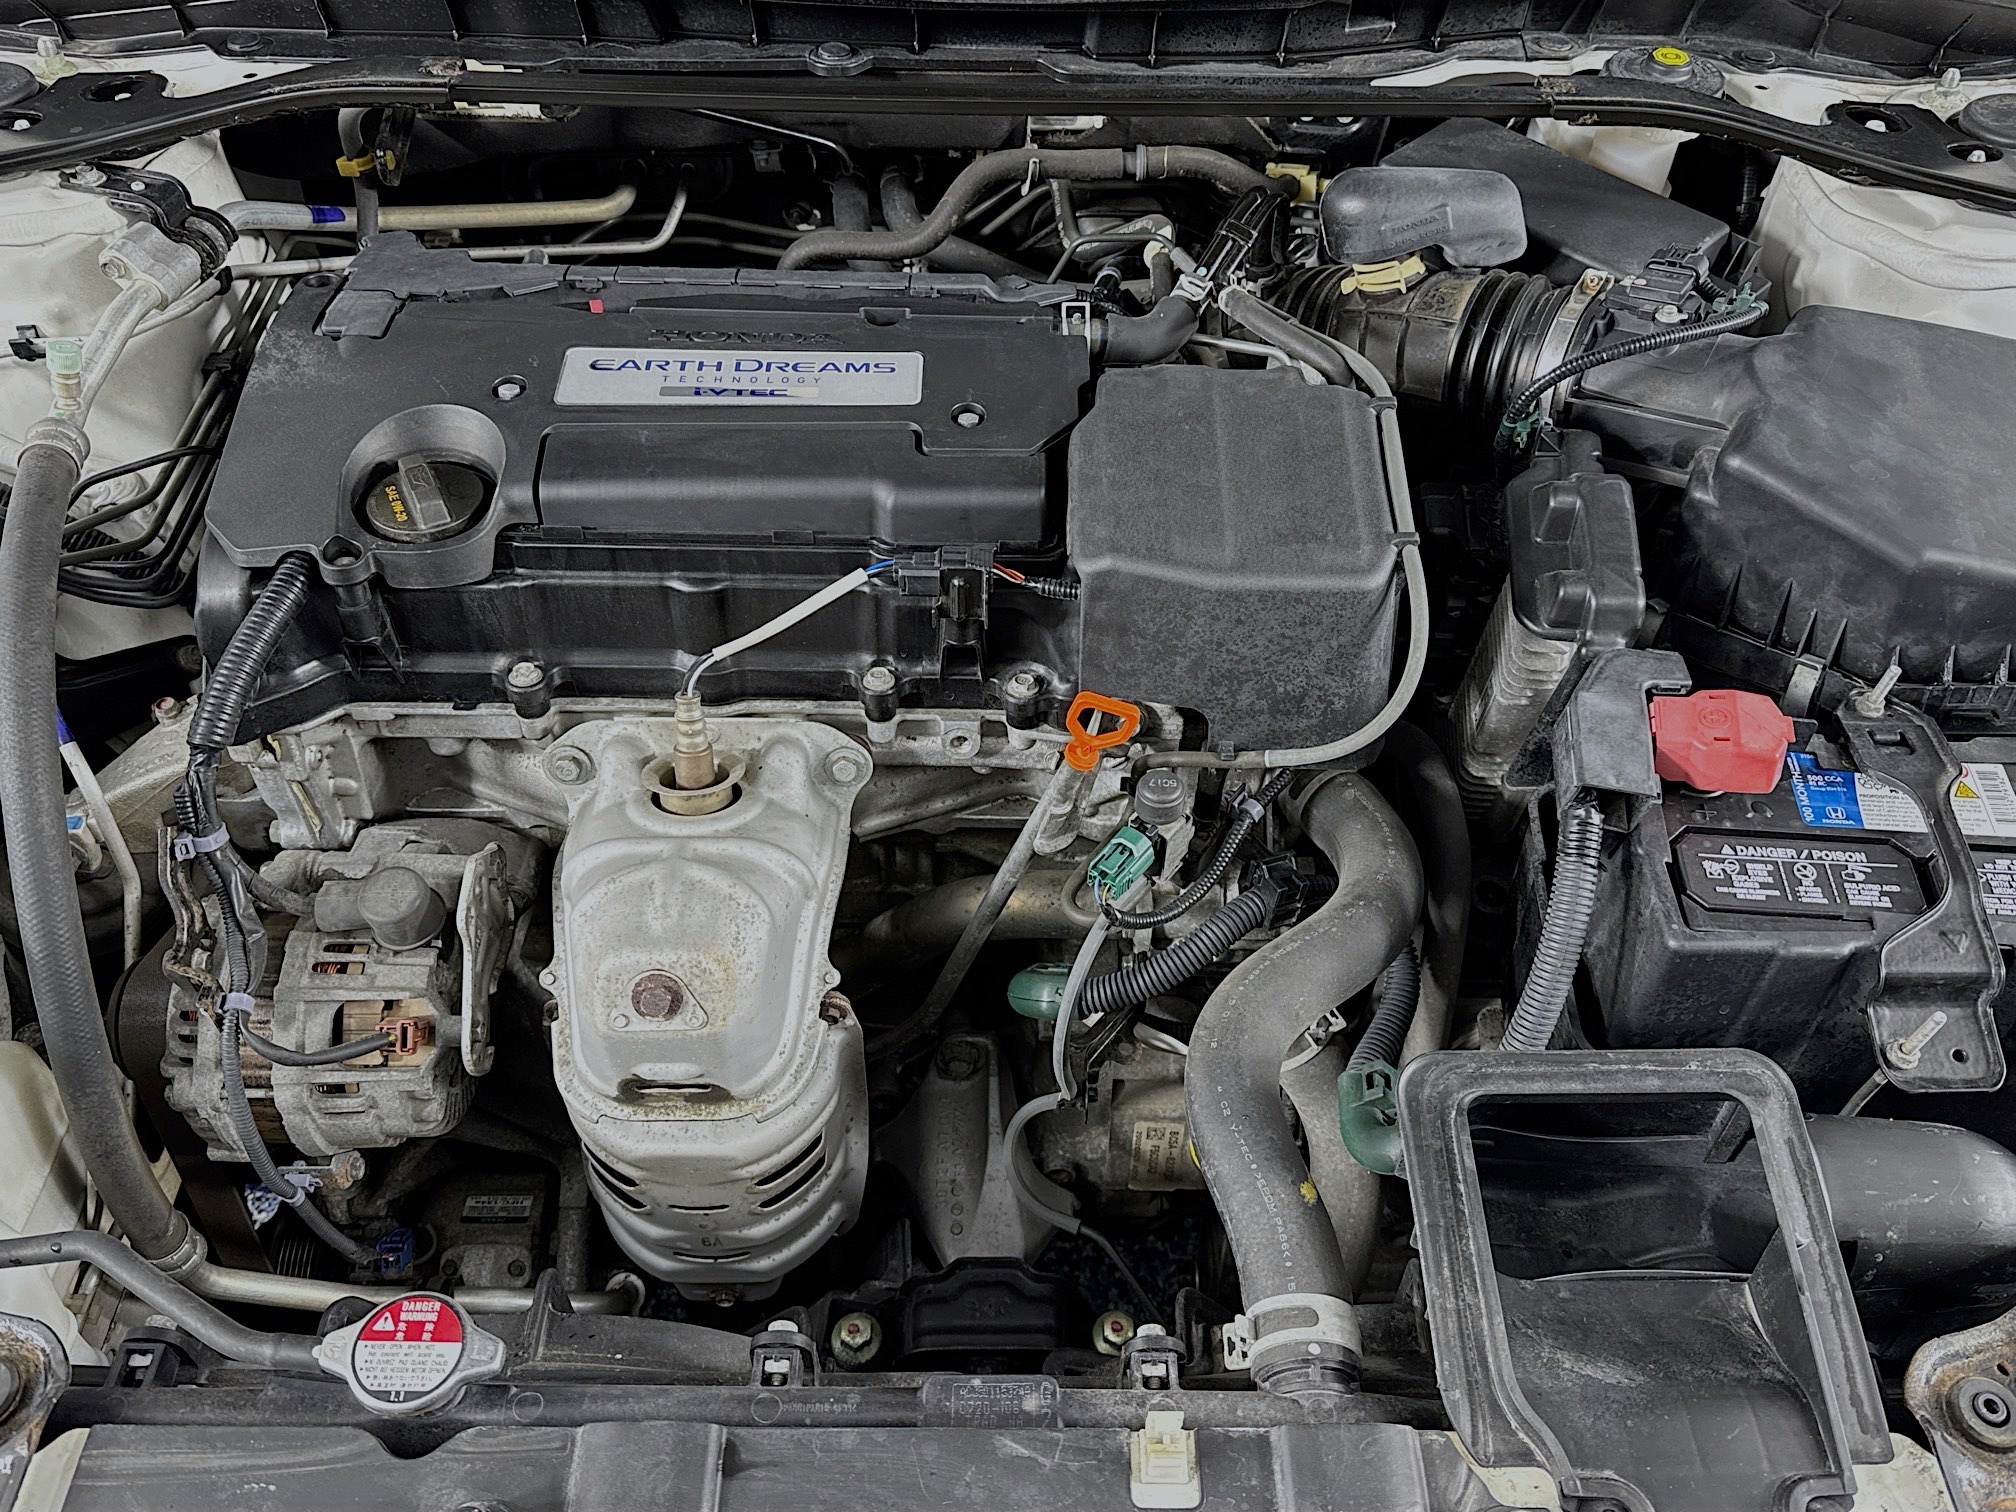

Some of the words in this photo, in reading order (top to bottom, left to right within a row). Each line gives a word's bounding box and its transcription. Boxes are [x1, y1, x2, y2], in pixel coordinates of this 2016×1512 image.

[648, 329, 844, 344] HONDA
[589, 359, 722, 371] EARTH
[734, 358, 897, 374] DREAMS
[662, 375, 823, 384] TECHNOLOGY
[693, 387, 790, 397] i-VTEC
[385, 485, 400, 501] SAE
[391, 500, 408, 522] 0W-20
[1791, 772, 1810, 805] MONTH
[1802, 807, 1815, 822] 100
[1736, 845, 1797, 859] DANGER
[1812, 850, 1868, 863] POISON
[402, 1301, 441, 1311] DANGER
